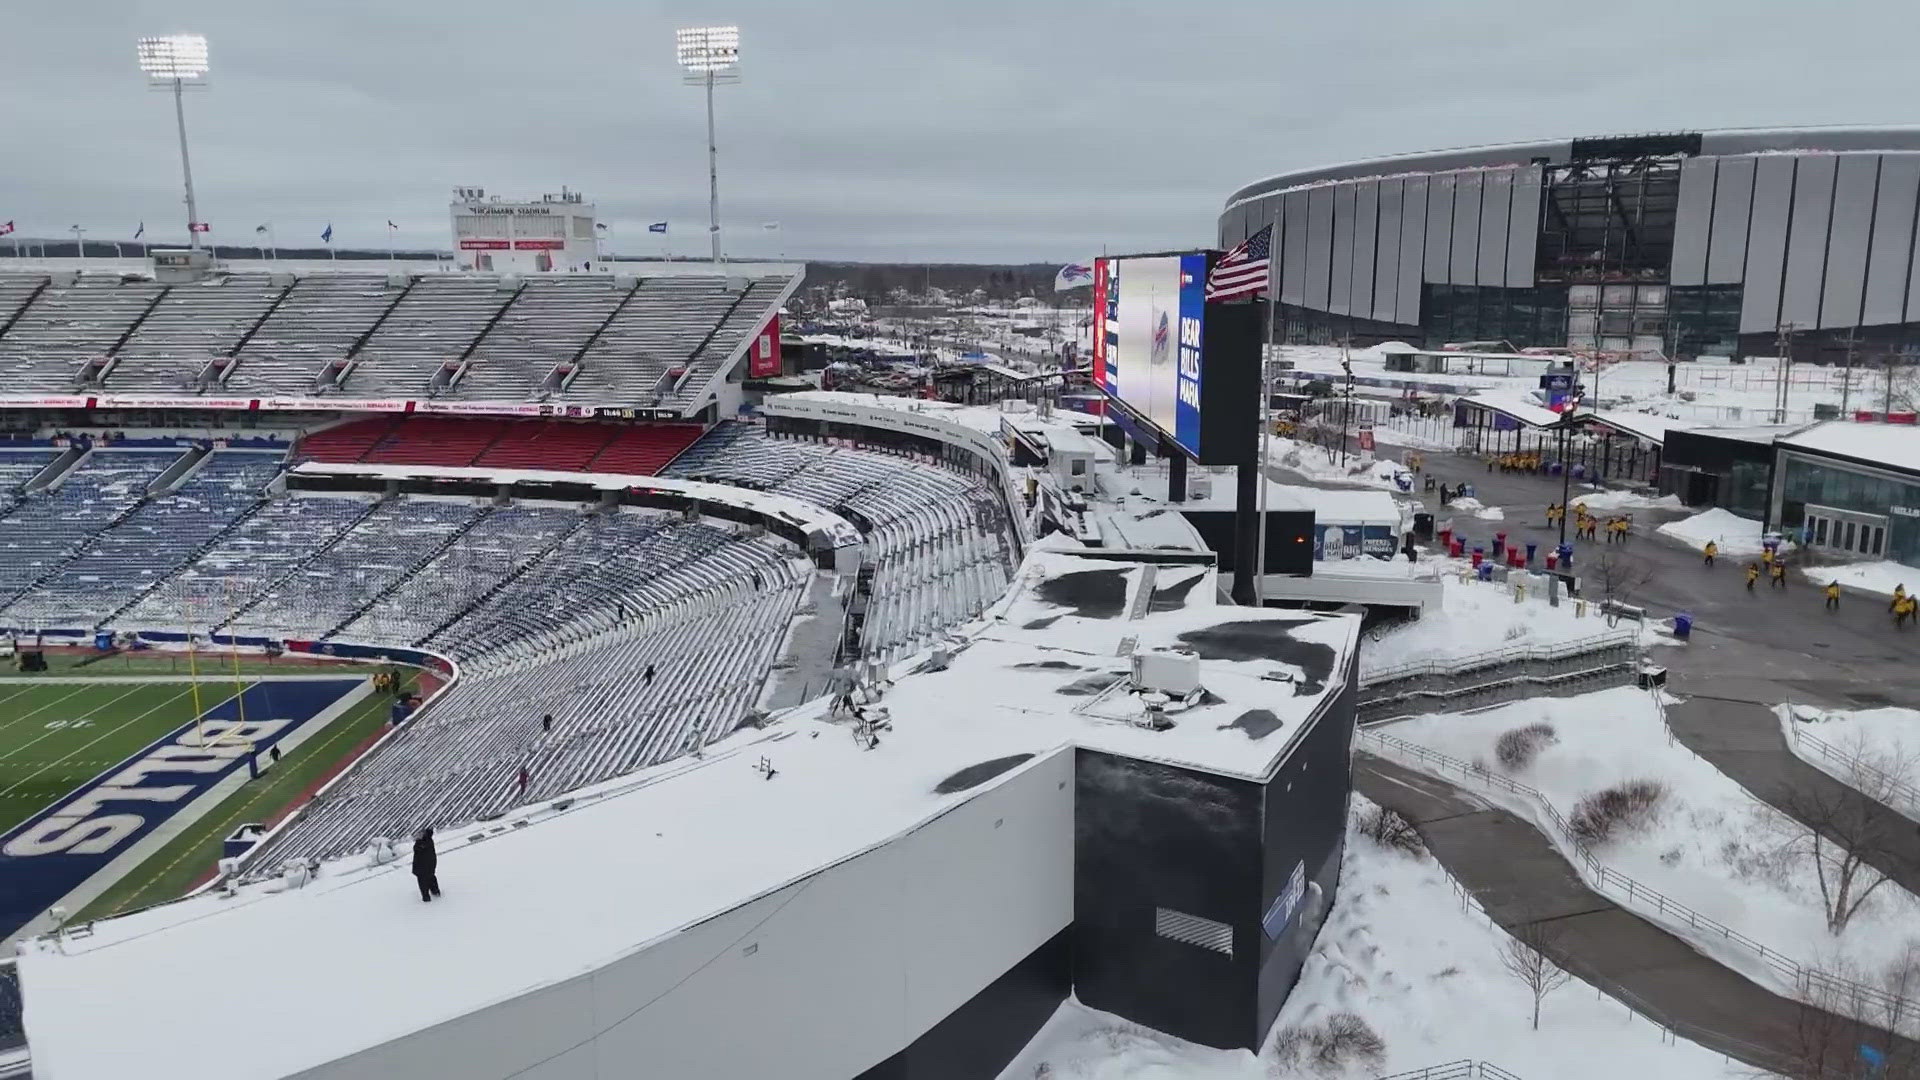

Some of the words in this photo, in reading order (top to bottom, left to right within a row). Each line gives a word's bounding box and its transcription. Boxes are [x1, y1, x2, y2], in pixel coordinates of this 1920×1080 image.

[517, 207, 550, 215] STADIUM
[1181, 317, 1200, 347] DEAR
[1180, 347, 1200, 380] BILLS
[1179, 377, 1200, 412] MAFIA
[2, 718, 294, 856] BILLS
